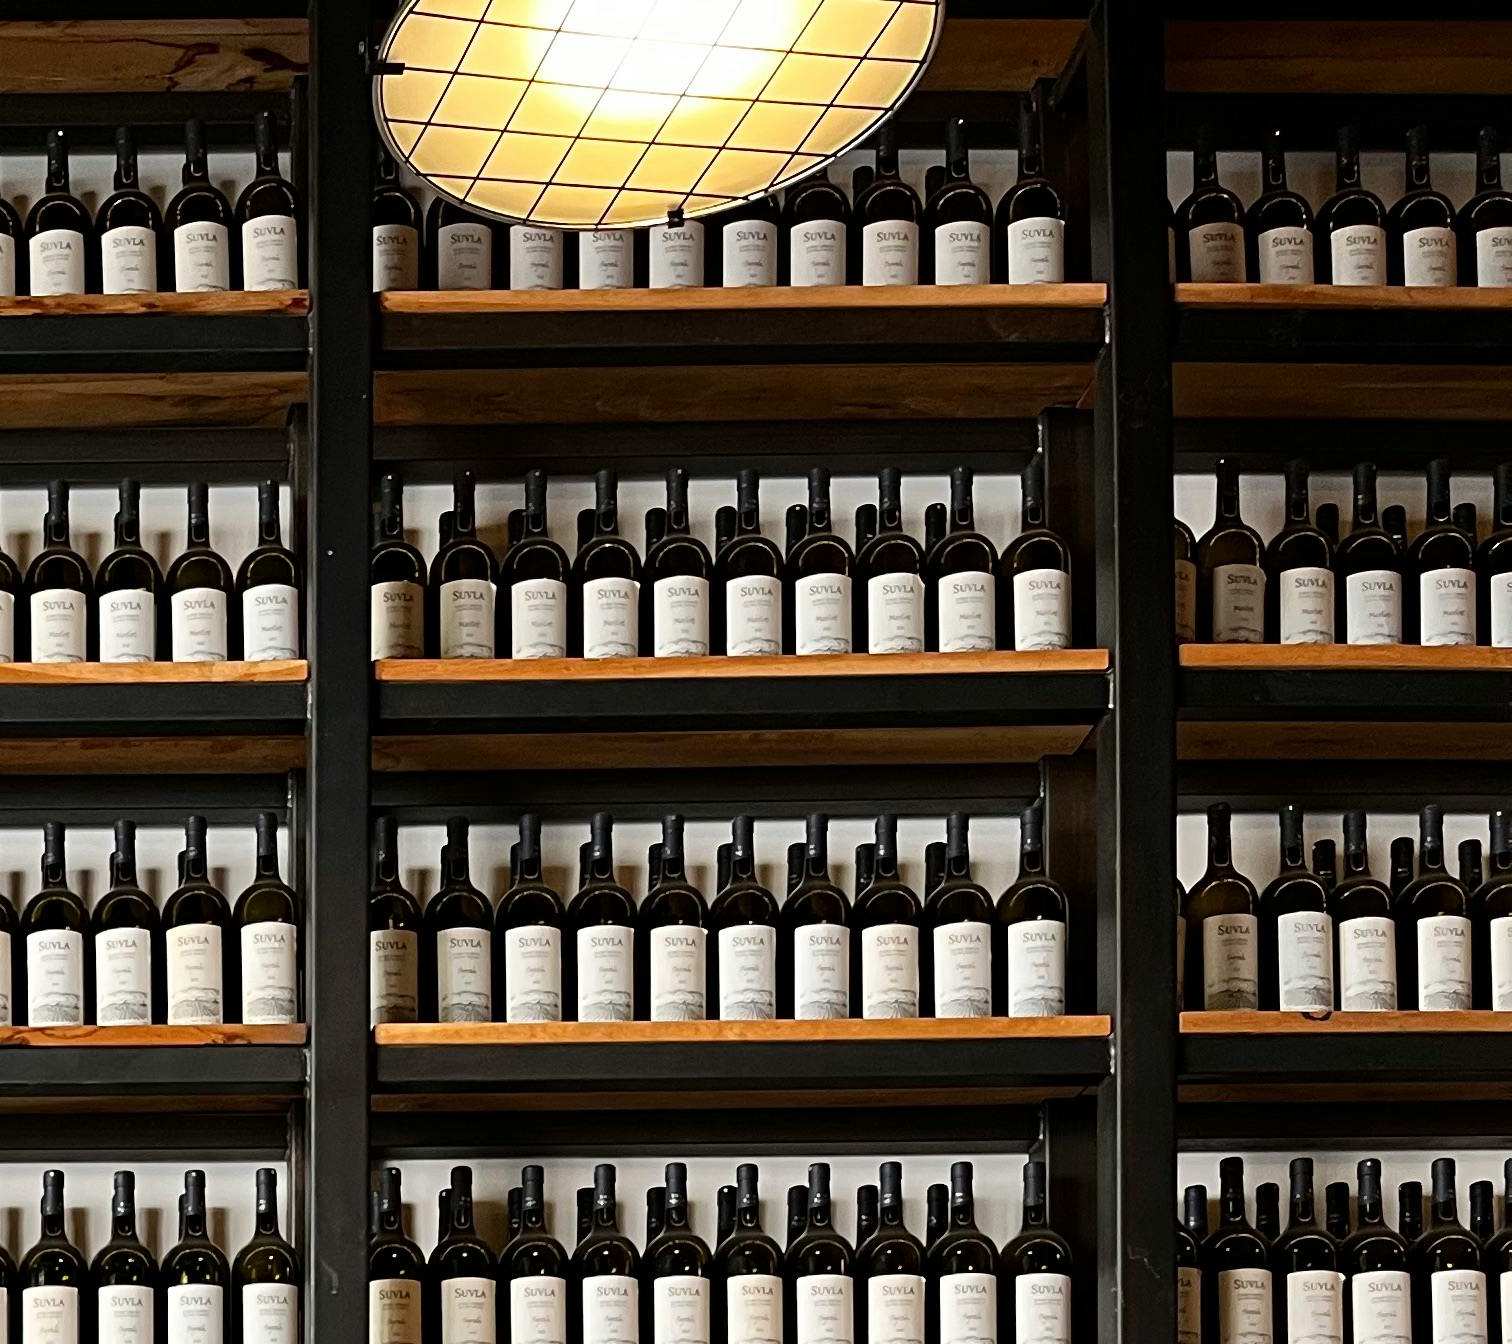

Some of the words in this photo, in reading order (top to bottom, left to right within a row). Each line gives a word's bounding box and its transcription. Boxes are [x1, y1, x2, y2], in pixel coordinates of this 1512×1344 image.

[185, 232, 219, 245] SUVLA
[375, 234, 409, 247] SUVLA
[450, 232, 483, 246] SUVLA
[522, 231, 556, 244] SUVLA
[661, 231, 696, 243] SUVLA
[735, 230, 769, 242] SUVLA
[803, 231, 837, 243] SUVLA
[876, 231, 911, 243] SUVLA
[948, 231, 982, 244] SUVLA
[1021, 228, 1056, 241] SUVLA
[1202, 231, 1238, 244] SUVLA
[1345, 235, 1379, 247] SUVLA
[39, 240, 73, 253] SUVLA
[1271, 236, 1305, 249] SUVLA
[1226, 573, 1259, 587] SUVLA
[1361, 581, 1396, 592] SUVLA
[1435, 578, 1469, 591] SUVLA
[667, 586, 701, 599] SUVLA
[740, 586, 775, 598] SUVLA
[808, 584, 843, 597] SUVLA
[952, 583, 987, 595] SUVLA
[254, 595, 289, 607] SUVLA
[383, 590, 415, 603] SUVLA
[452, 589, 486, 603] SUVLA
[524, 590, 558, 602] SUVLA
[42, 600, 76, 612] SUVLA
[947, 933, 982, 945] SUVLA
[1022, 931, 1057, 944] SUVLA
[1353, 928, 1389, 940] SUVLA
[38, 940, 71, 952] SUVLA
[177, 935, 211, 948] SUVLA
[375, 940, 408, 953] SUVLA
[449, 936, 483, 949] SUVLA
[518, 936, 552, 949] SUVLA
[590, 936, 624, 949] SUVLA
[664, 936, 698, 949] SUVLA
[810, 934, 842, 948] SUVLA
[876, 935, 910, 947] SUVLA
[741, 1285, 774, 1296] SUVLA
[810, 1285, 845, 1297] SUVLA
[883, 1284, 915, 1298] SUVLA
[954, 1283, 988, 1295] SUVLA
[1233, 1278, 1267, 1291] SUVLA
[1367, 1279, 1403, 1293] SUVLA
[1447, 1280, 1481, 1292] SUVLA
[378, 1289, 412, 1301] SUVLA
[454, 1287, 487, 1300] SUVLA
[524, 1286, 557, 1298] SUVLA
[596, 1286, 630, 1297] SUVLA
[668, 1286, 702, 1297] SUVLA
[111, 1295, 144, 1308] SUVLA
[180, 1295, 213, 1307] SUVLA
